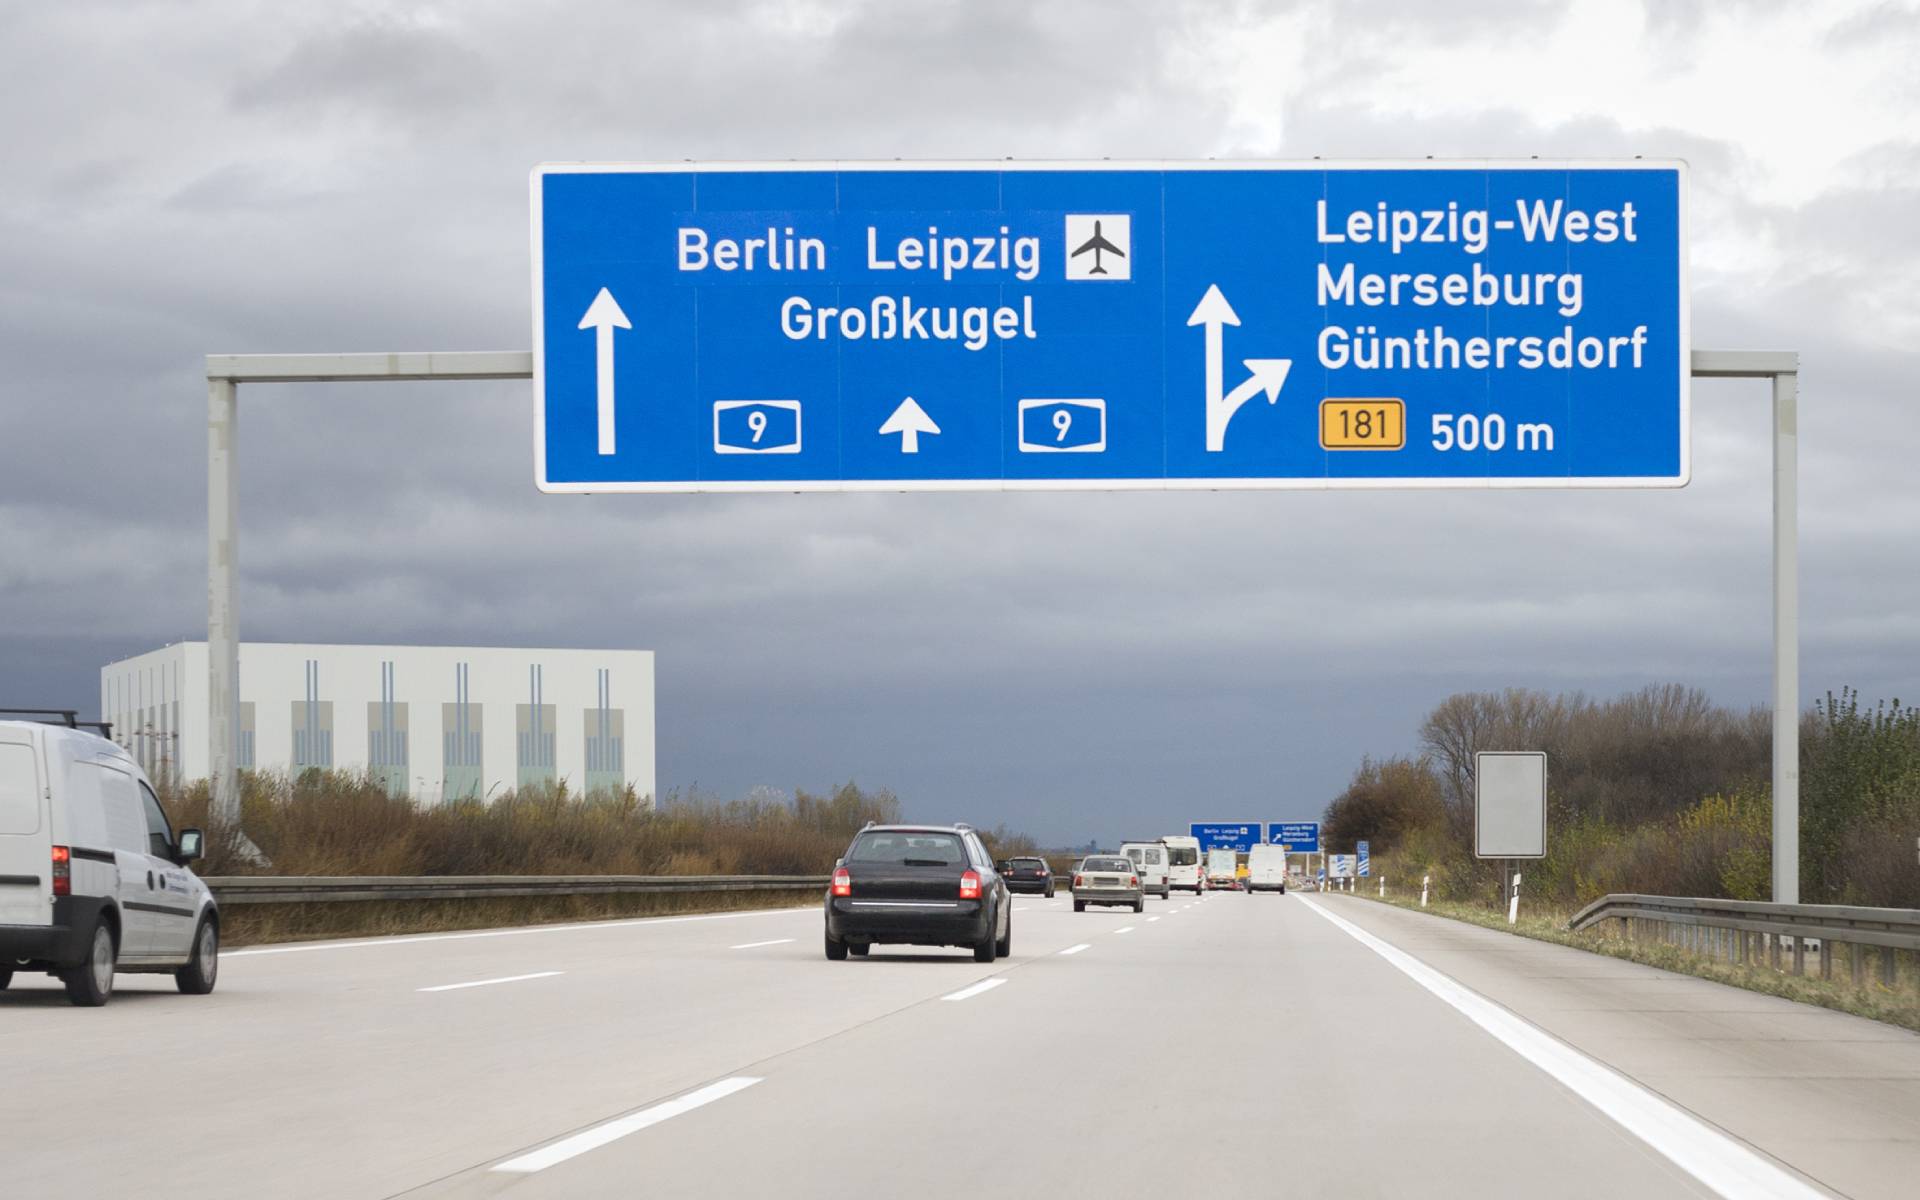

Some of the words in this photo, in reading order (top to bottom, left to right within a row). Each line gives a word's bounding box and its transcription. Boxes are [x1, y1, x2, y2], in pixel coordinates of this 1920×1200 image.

[1317, 199, 1637, 254] Leipzig-West
[678, 227, 825, 271] Berlin
[867, 226, 1040, 281] Leipzig
[1317, 262, 1583, 317] Merseburg
[781, 295, 1037, 351] Großkugel
[1318, 325, 1648, 370] Günthersdorf
[748, 411, 767, 443] 9
[1052, 410, 1072, 442] 9
[1339, 409, 1386, 439] 181
[1432, 413, 1505, 451] 500
[1516, 423, 1554, 451] m
